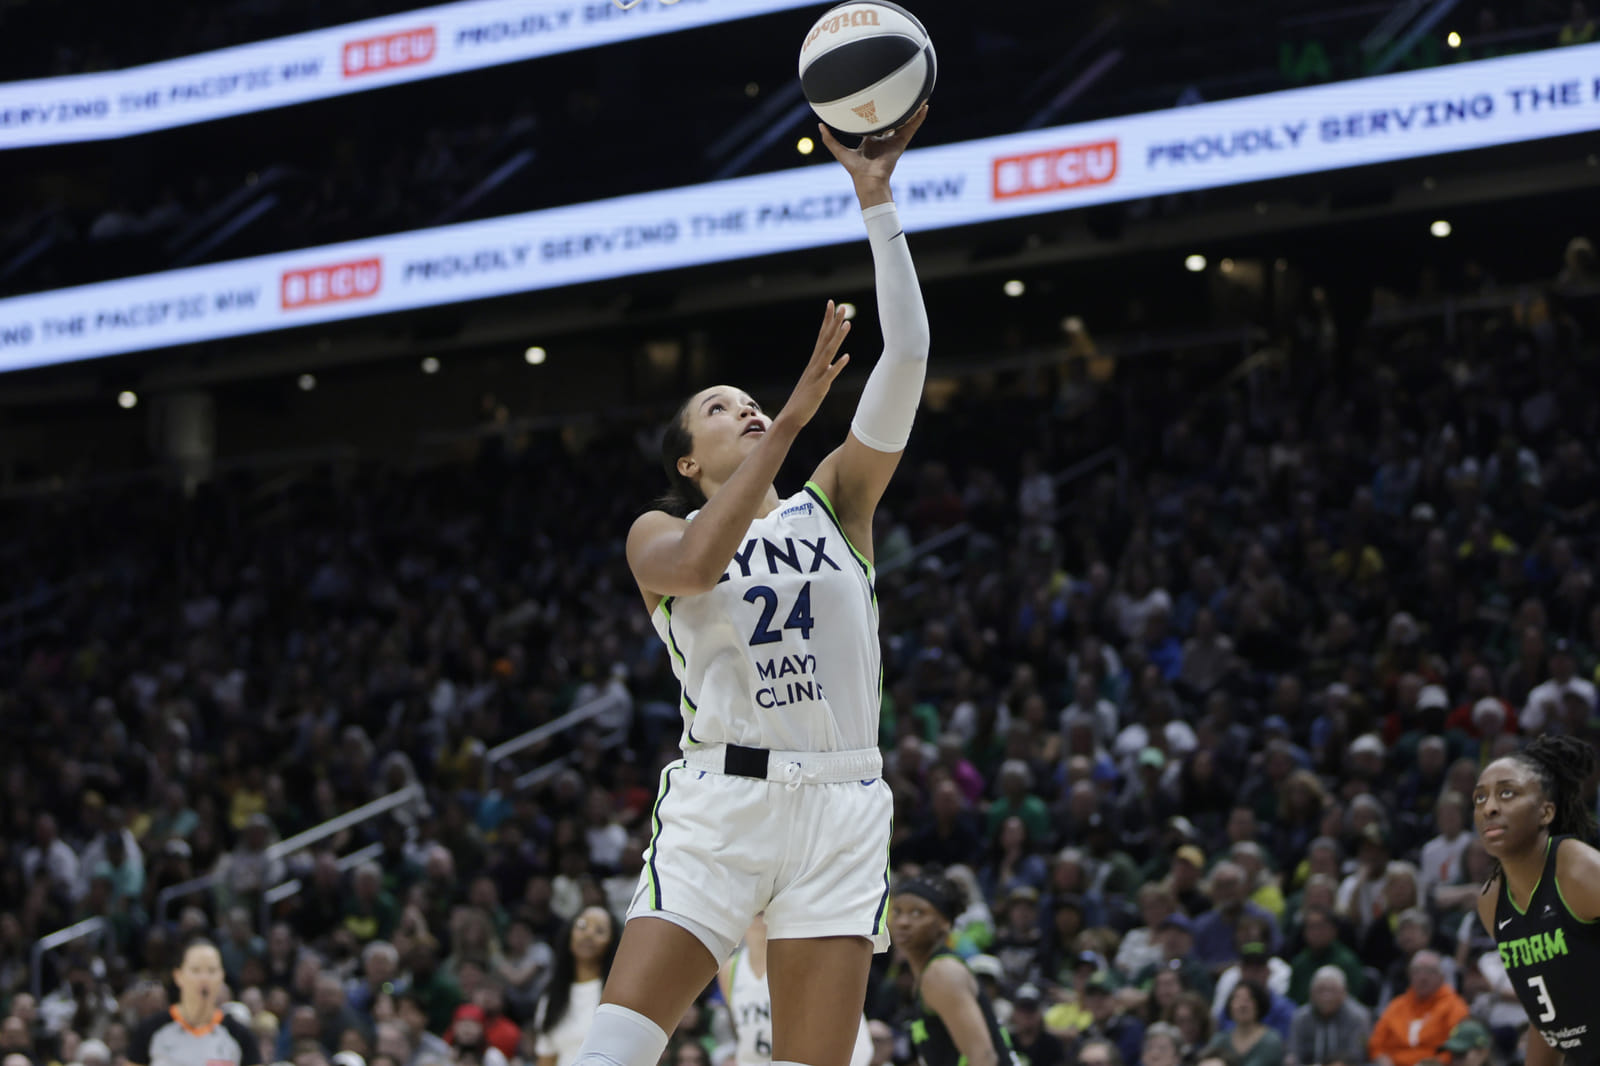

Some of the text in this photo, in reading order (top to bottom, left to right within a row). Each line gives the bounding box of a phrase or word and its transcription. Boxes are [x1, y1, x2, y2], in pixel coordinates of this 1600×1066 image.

[118, 87, 160, 113] THE
[169, 64, 273, 101] PACIFIC
[346, 29, 435, 74] BECU
[455, 10, 575, 48] PROUDLY
[42, 314, 86, 340] THE
[96, 292, 207, 330] PACIFIC
[286, 261, 379, 307] BECU
[403, 242, 531, 283] PROUDLY
[541, 219, 680, 263] SERVING
[690, 206, 748, 238] THE
[756, 193, 853, 224] PACIF
[908, 174, 966, 201] NW
[998, 143, 1115, 192] BECU
[1147, 119, 1307, 169] PROUDLY
[1318, 92, 1494, 143] SERVING
[1506, 77, 1581, 113] THE
[743, 581, 815, 646] 24
[1498, 927, 1569, 969] STORM
[1527, 975, 1557, 1024] 3
